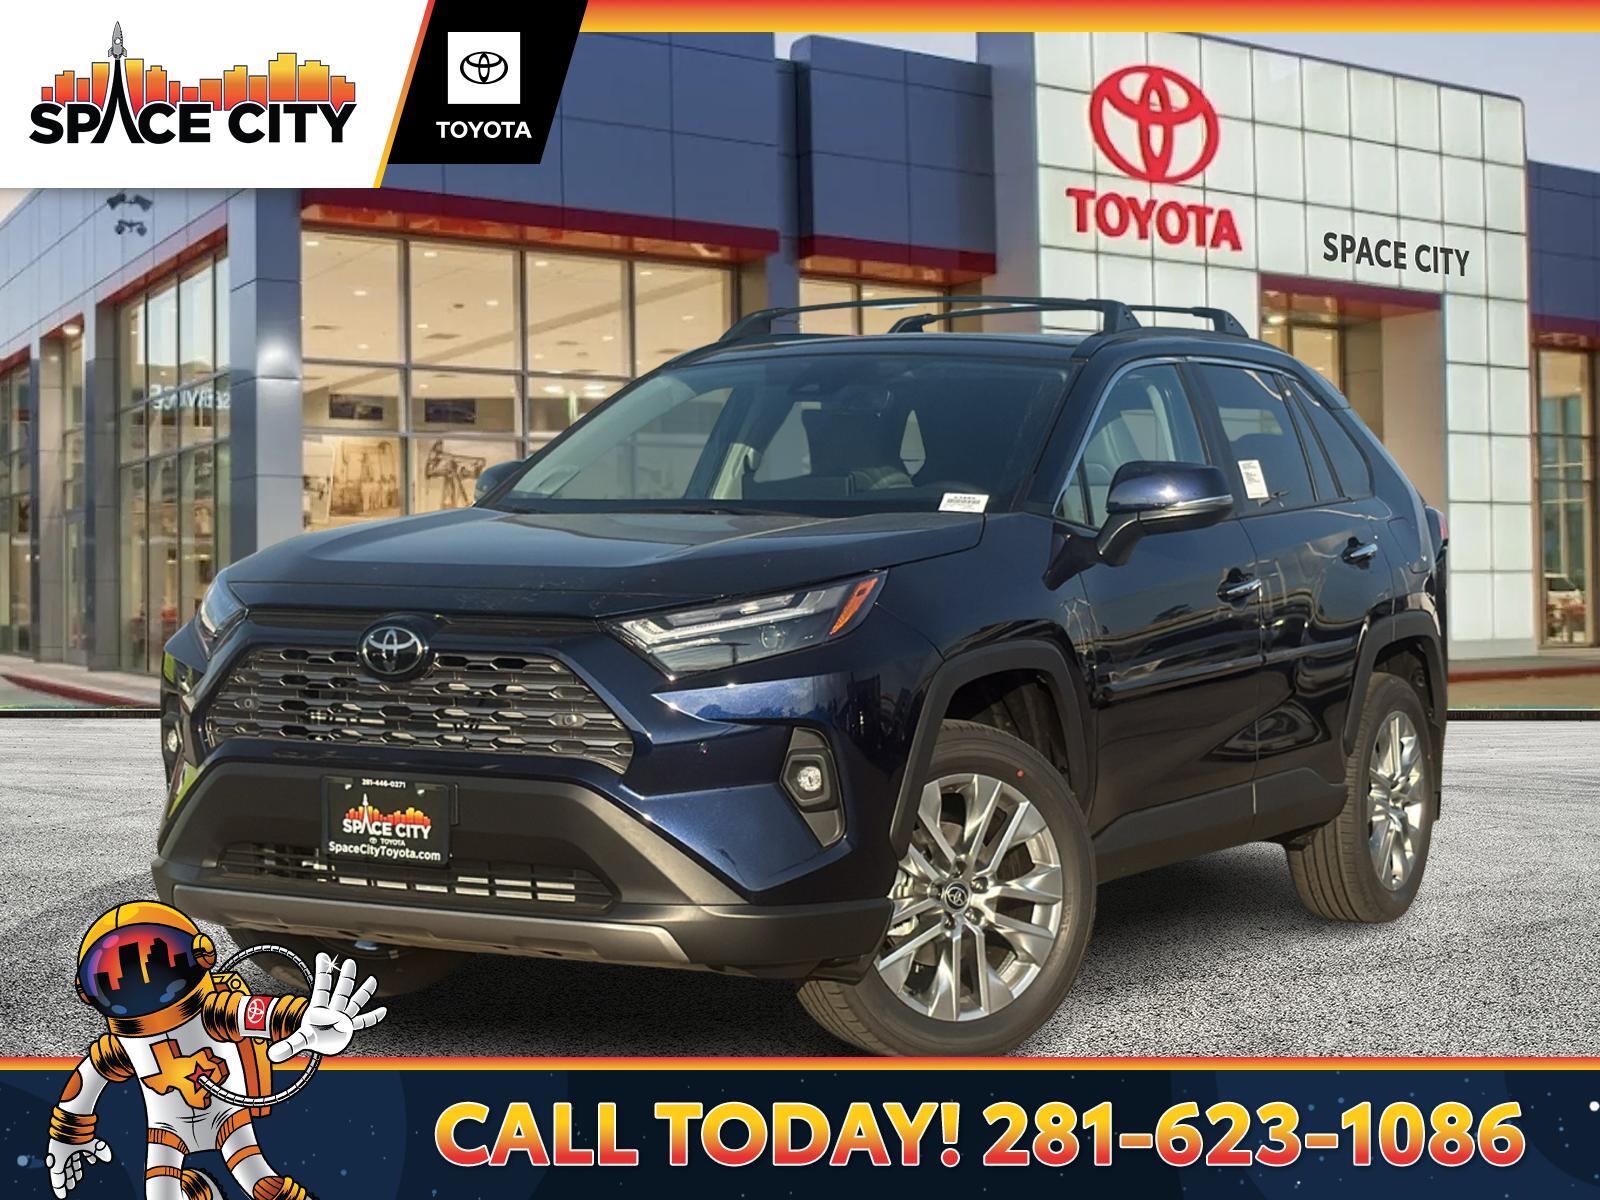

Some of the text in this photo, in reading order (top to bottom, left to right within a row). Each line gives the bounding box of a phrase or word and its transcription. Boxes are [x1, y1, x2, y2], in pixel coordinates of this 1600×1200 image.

[1066, 188, 1242, 250] TOYOTA
[1322, 232, 1470, 277] SPACE CITY
[342, 814, 432, 840] SPACE CITY
[328, 841, 441, 861] SpaceCityToyota.com
[380, 838, 406, 847] TOYOTA
